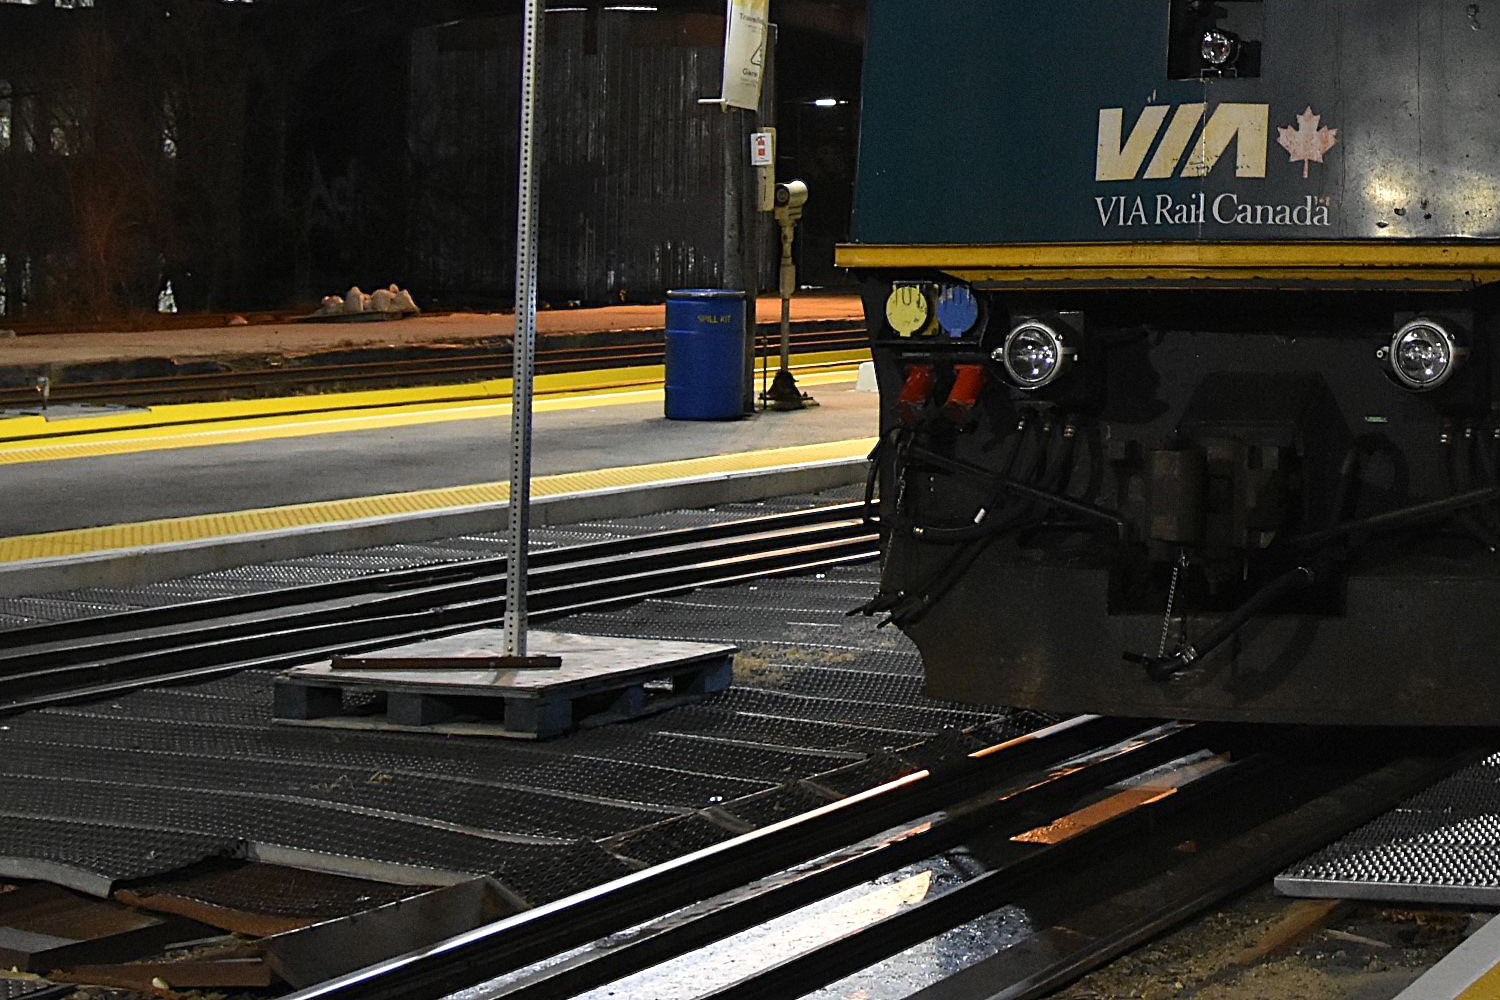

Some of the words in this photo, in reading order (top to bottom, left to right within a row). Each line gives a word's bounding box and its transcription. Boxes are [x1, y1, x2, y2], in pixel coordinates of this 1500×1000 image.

[1096, 102, 1270, 181] VIA
[1095, 196, 1149, 226] VIA
[1155, 192, 1206, 225] Rail
[1212, 193, 1332, 226] Canada
